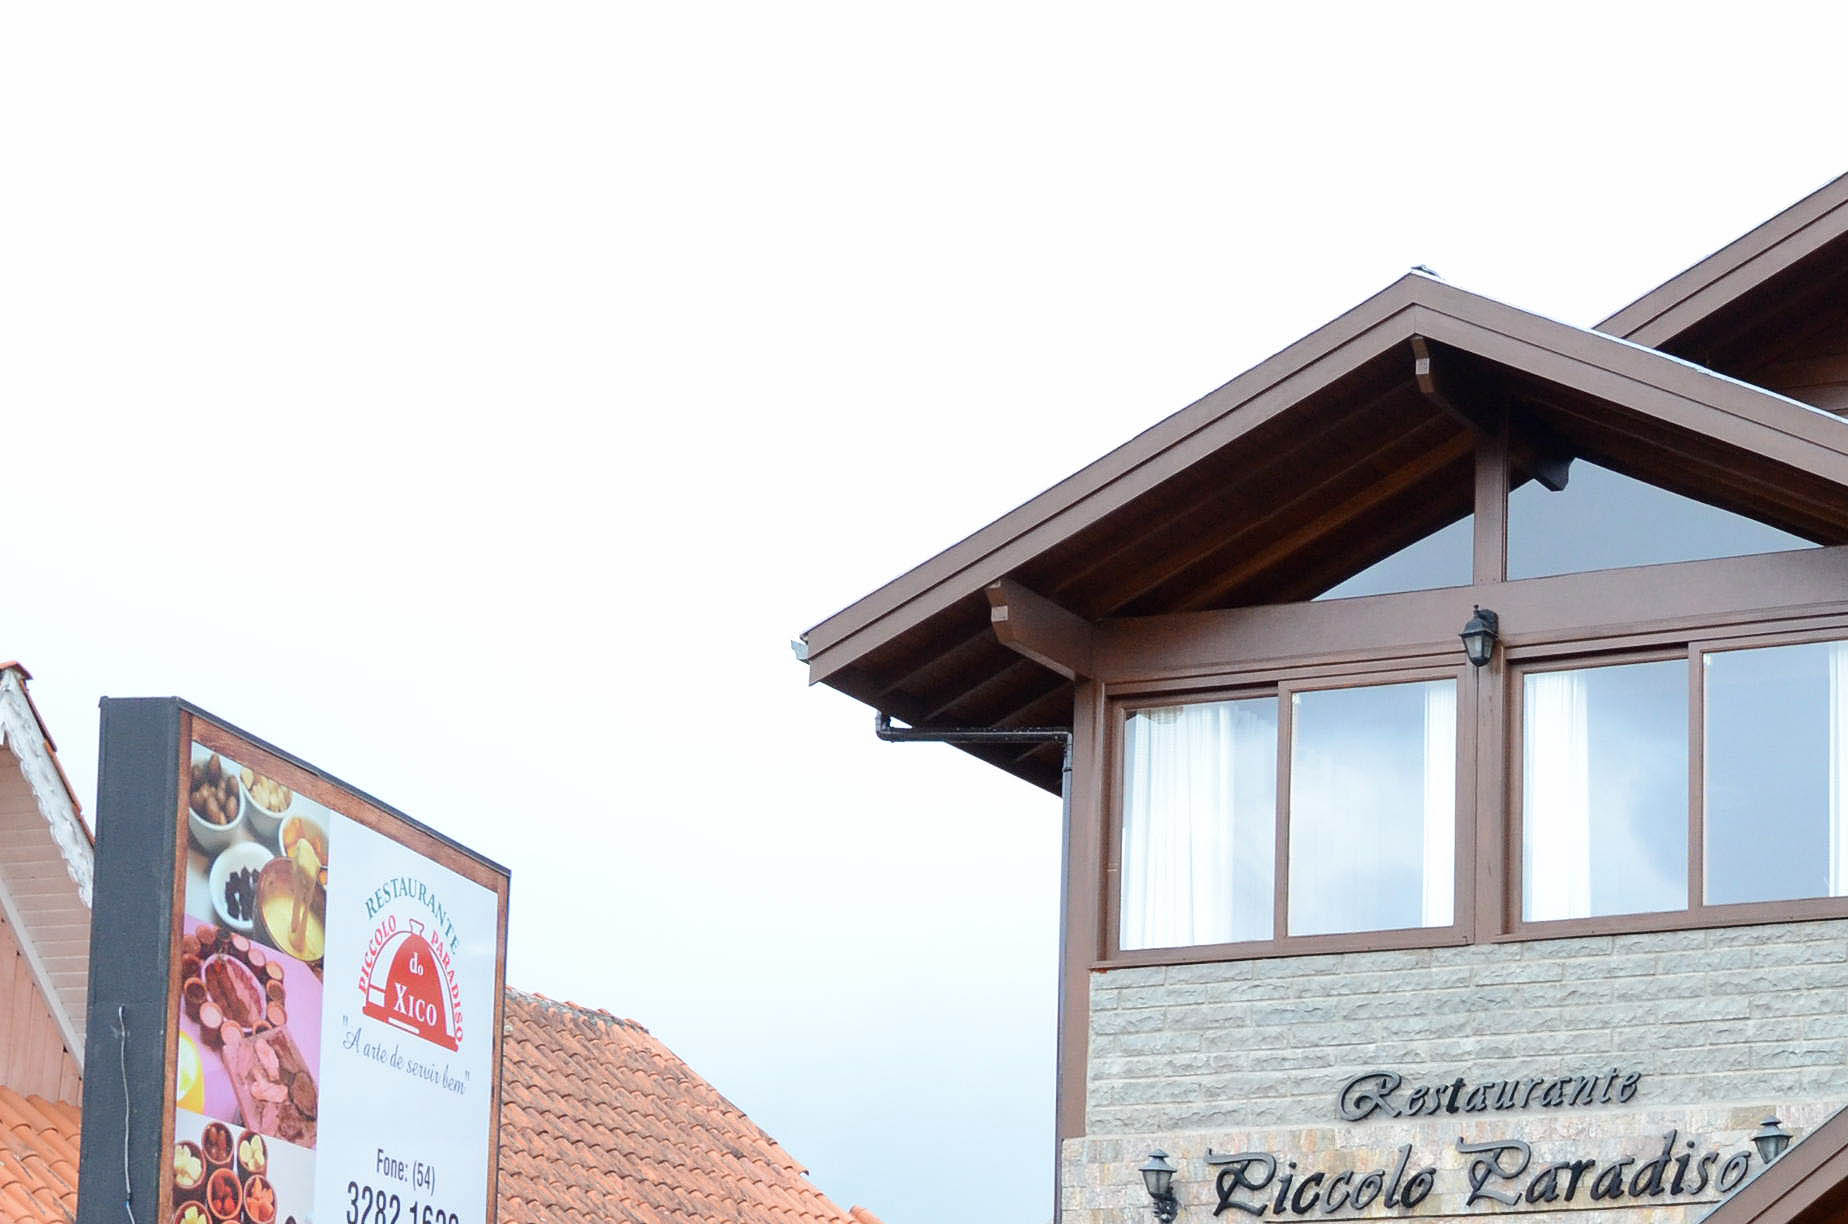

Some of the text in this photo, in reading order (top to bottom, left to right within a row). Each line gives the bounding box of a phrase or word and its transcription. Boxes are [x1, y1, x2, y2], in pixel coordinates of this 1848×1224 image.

[365, 877, 460, 954] RESTAURANTE
[358, 914, 464, 1044] PICCOLO PARADISO
[409, 952, 424, 976] do
[363, 1042, 388, 1064] arte
[389, 1045, 403, 1071] de
[406, 1060, 440, 1086] servir
[1339, 1067, 1641, 1122] Restaurante
[376, 1148, 436, 1196] Fone: (54)
[1207, 1129, 1753, 1217] Piccolo Paradiso
